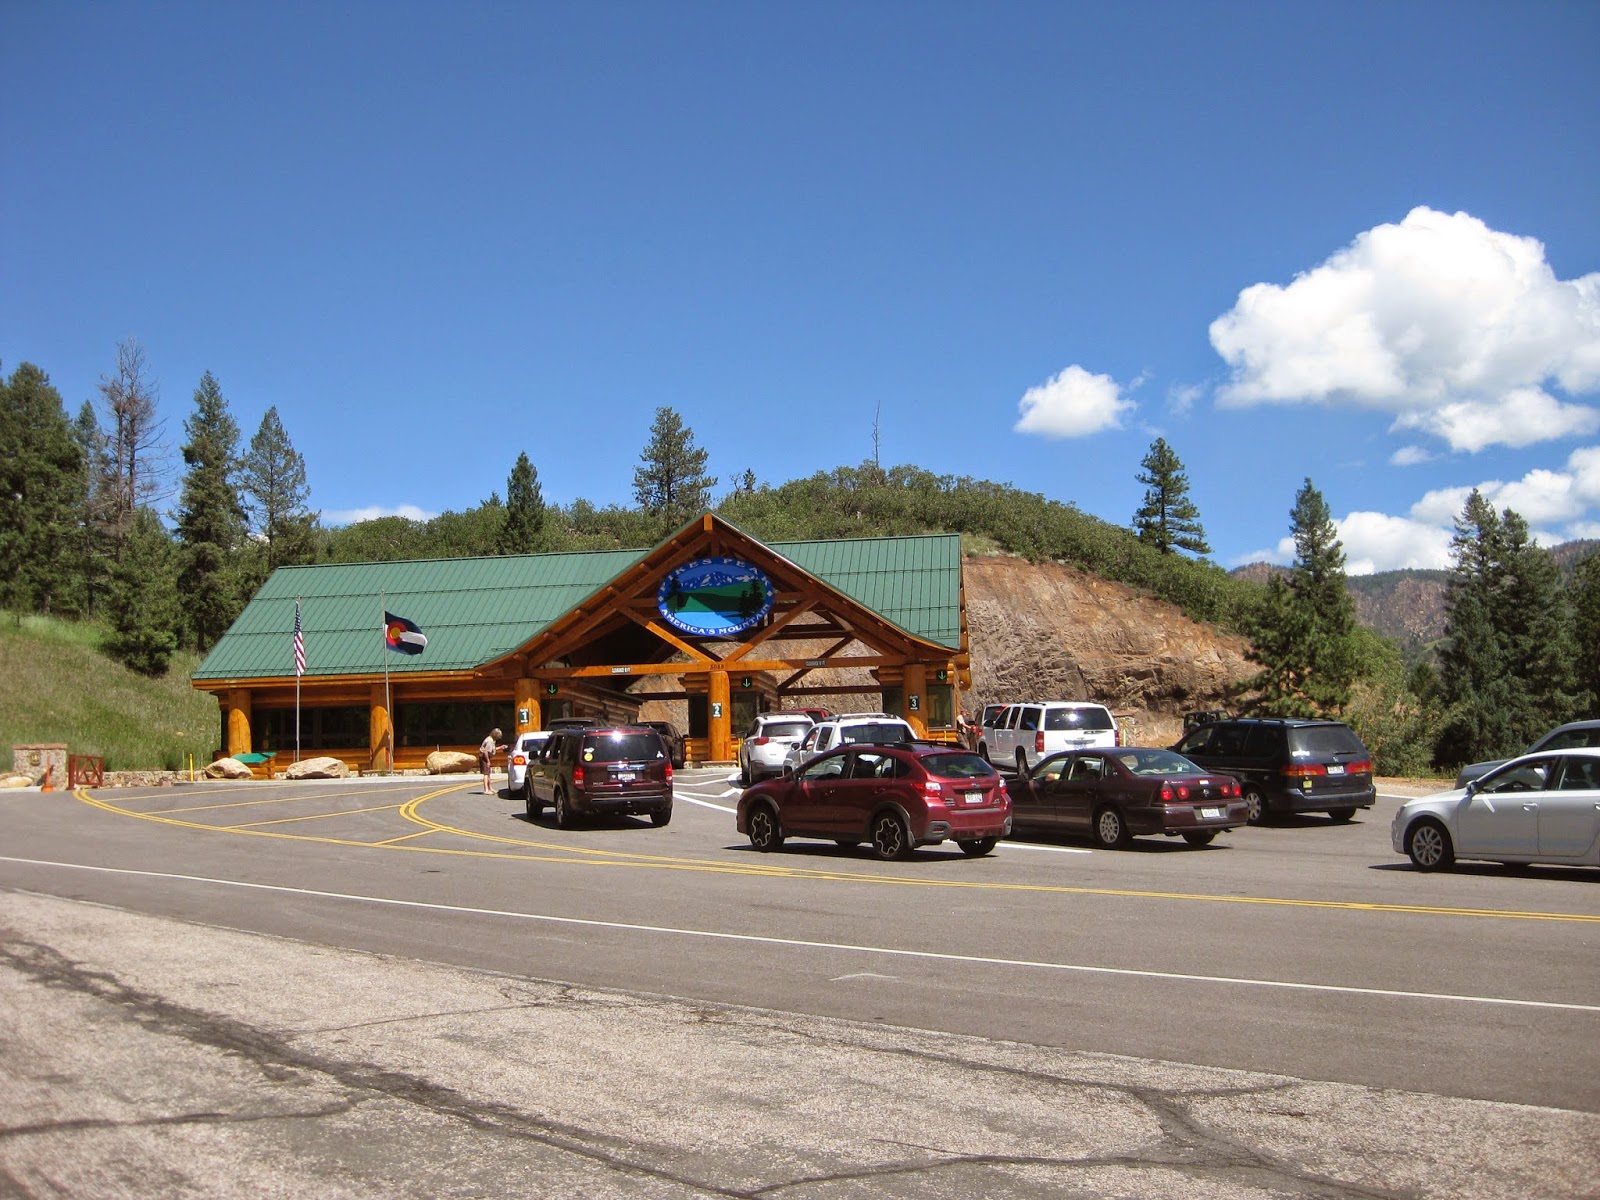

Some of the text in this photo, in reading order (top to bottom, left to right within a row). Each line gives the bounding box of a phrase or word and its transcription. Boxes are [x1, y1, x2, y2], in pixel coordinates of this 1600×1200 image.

[661, 603, 770, 635] AMERICA'S MOUNTAIN
[714, 706, 720, 715] 2
